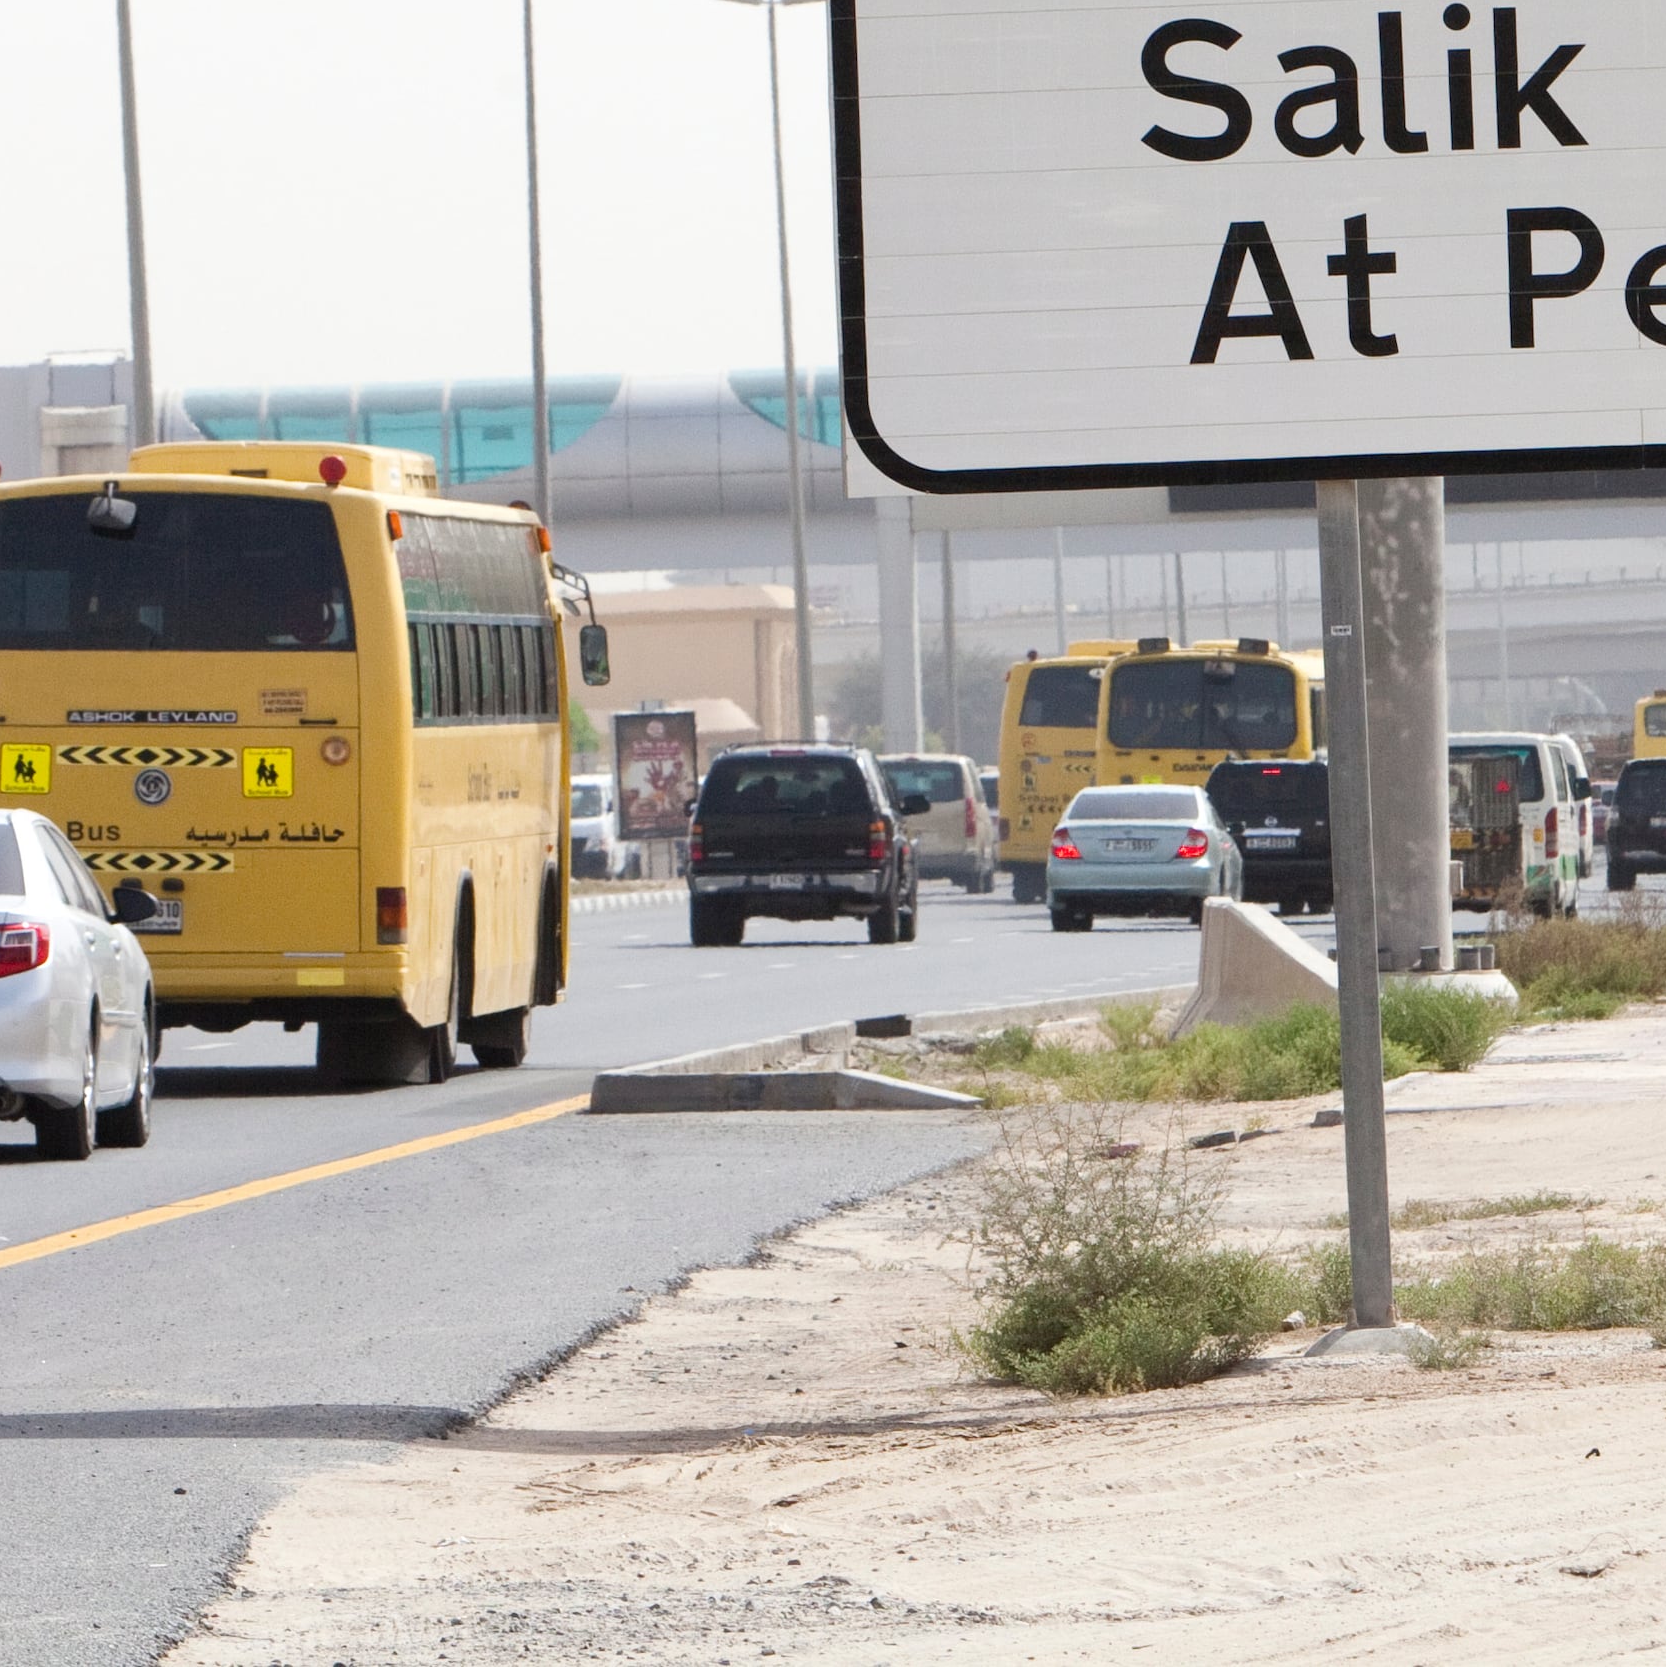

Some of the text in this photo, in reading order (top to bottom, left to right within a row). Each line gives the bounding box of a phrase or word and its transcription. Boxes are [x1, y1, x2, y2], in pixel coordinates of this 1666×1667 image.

[1140, 3, 1589, 162] Salik
[1189, 213, 1399, 365] At
[68, 710, 237, 723] ASHOK LEYLAND
[65, 820, 121, 842] Bus
[279, 822, 345, 843] حافلة
